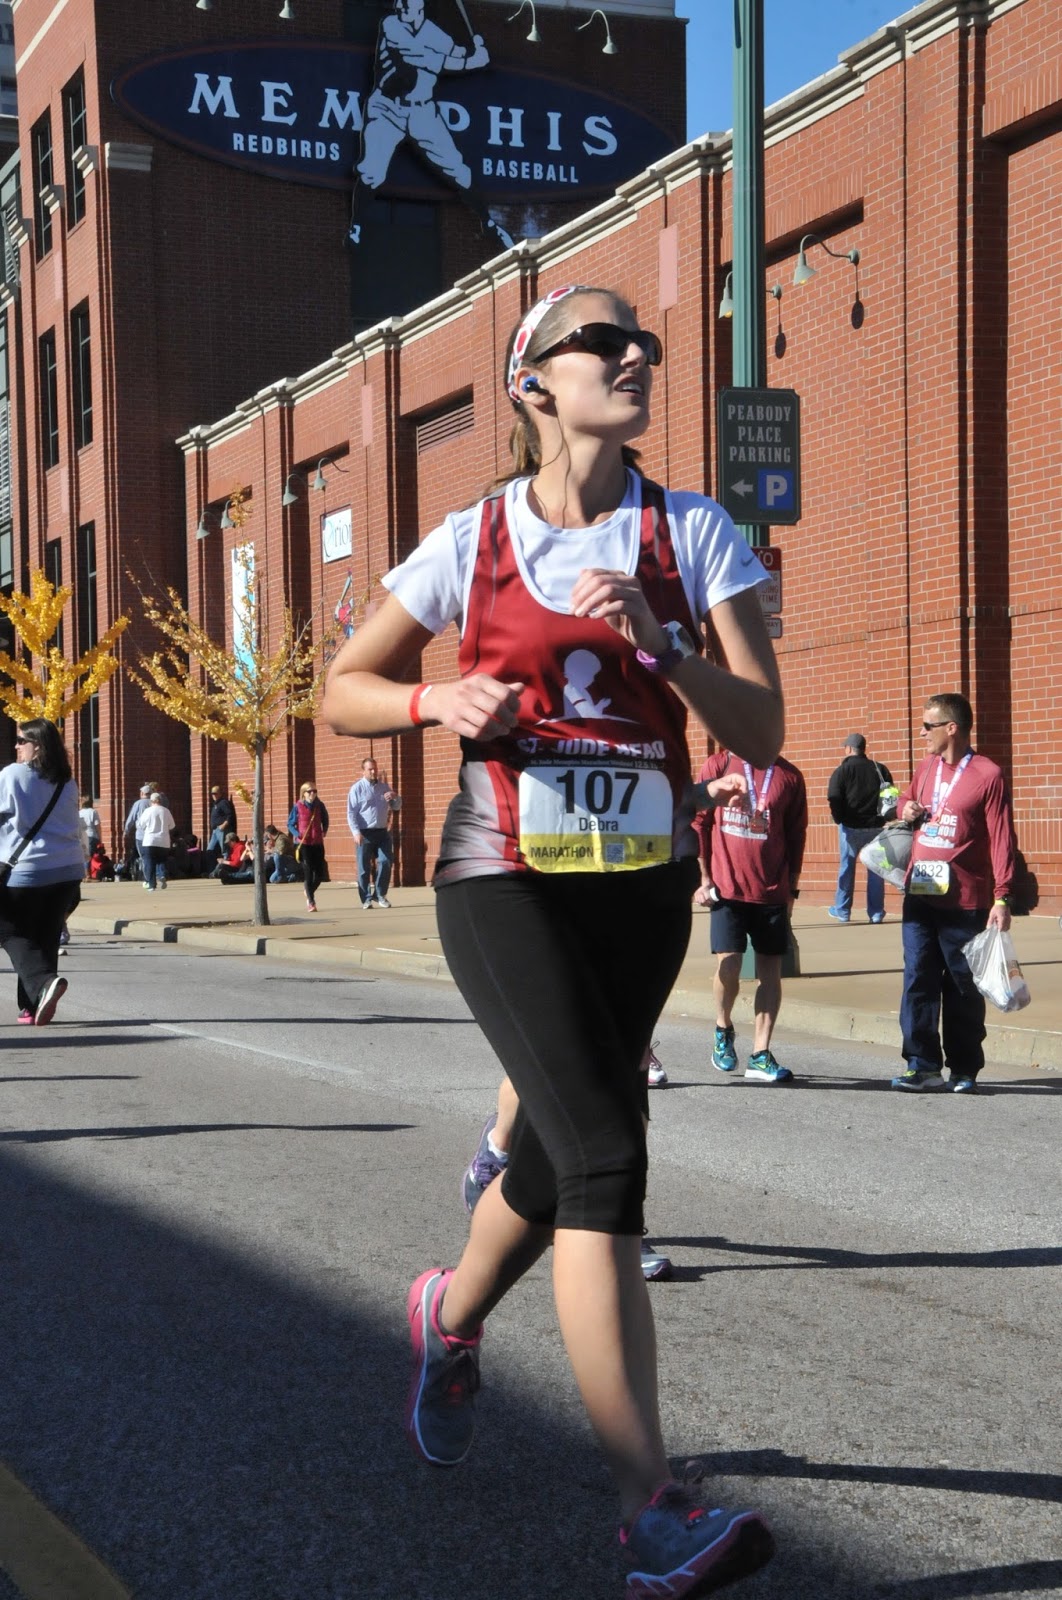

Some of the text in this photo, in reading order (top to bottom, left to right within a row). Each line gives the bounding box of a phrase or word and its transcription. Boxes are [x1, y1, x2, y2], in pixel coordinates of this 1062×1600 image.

[188, 73, 619, 156] MEMPHIS
[233, 132, 340, 161] REDBIRDS
[482, 158, 579, 184] BASEBALL
[727, 404, 791, 421] PEABODY
[738, 426, 782, 443] PLACE
[729, 446, 791, 463] PARKING
[766, 474, 788, 506] P
[553, 738, 610, 756] JUDE
[556, 770, 640, 815] 107
[579, 817, 619, 832] Debra
[530, 845, 594, 859] MARATHON
[914, 864, 944, 878] 3832
